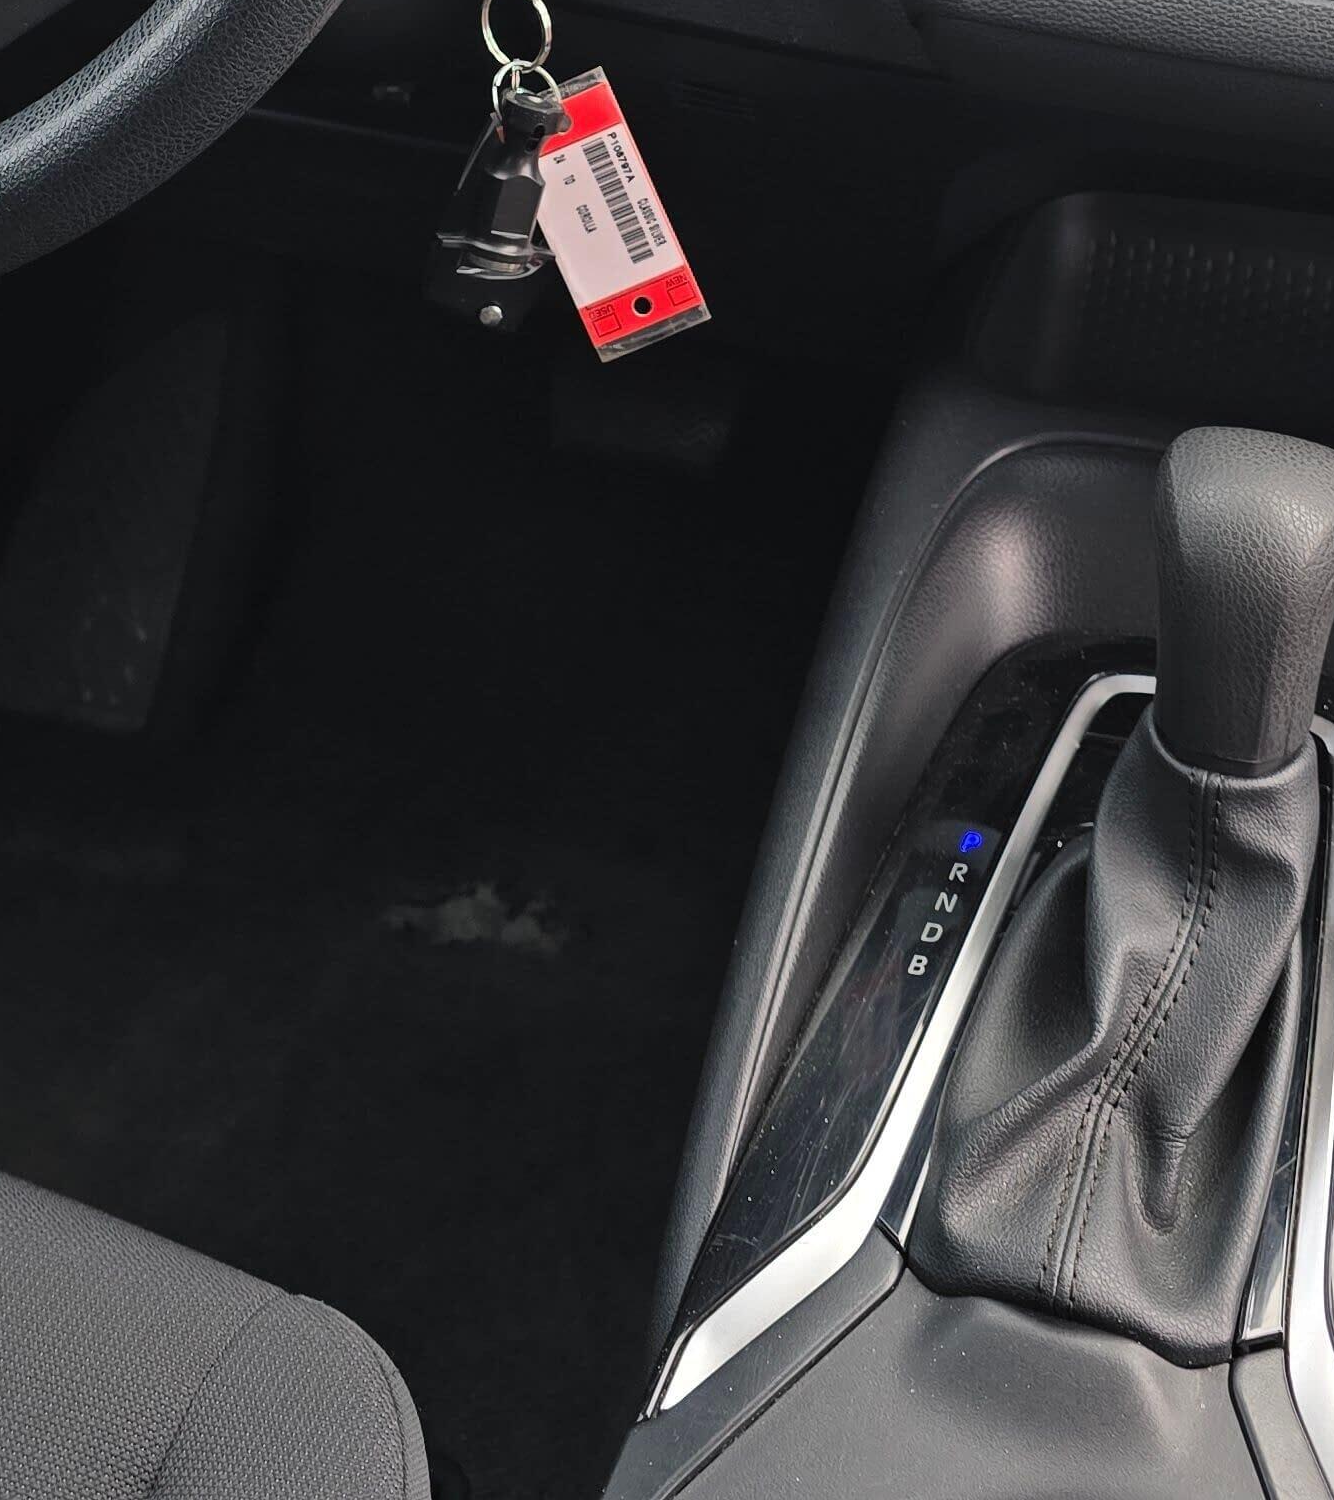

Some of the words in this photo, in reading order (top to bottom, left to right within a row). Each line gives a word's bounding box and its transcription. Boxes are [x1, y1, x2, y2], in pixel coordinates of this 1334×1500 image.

[575, 204, 597, 235] COROLLA
[637, 197, 657, 225] CLASSIC
[666, 272, 687, 289] NEW
[588, 303, 616, 321] USED
[948, 862, 969, 883] R
[934, 891, 958, 913] N
[920, 921, 944, 943] D
[907, 954, 929, 976] B
